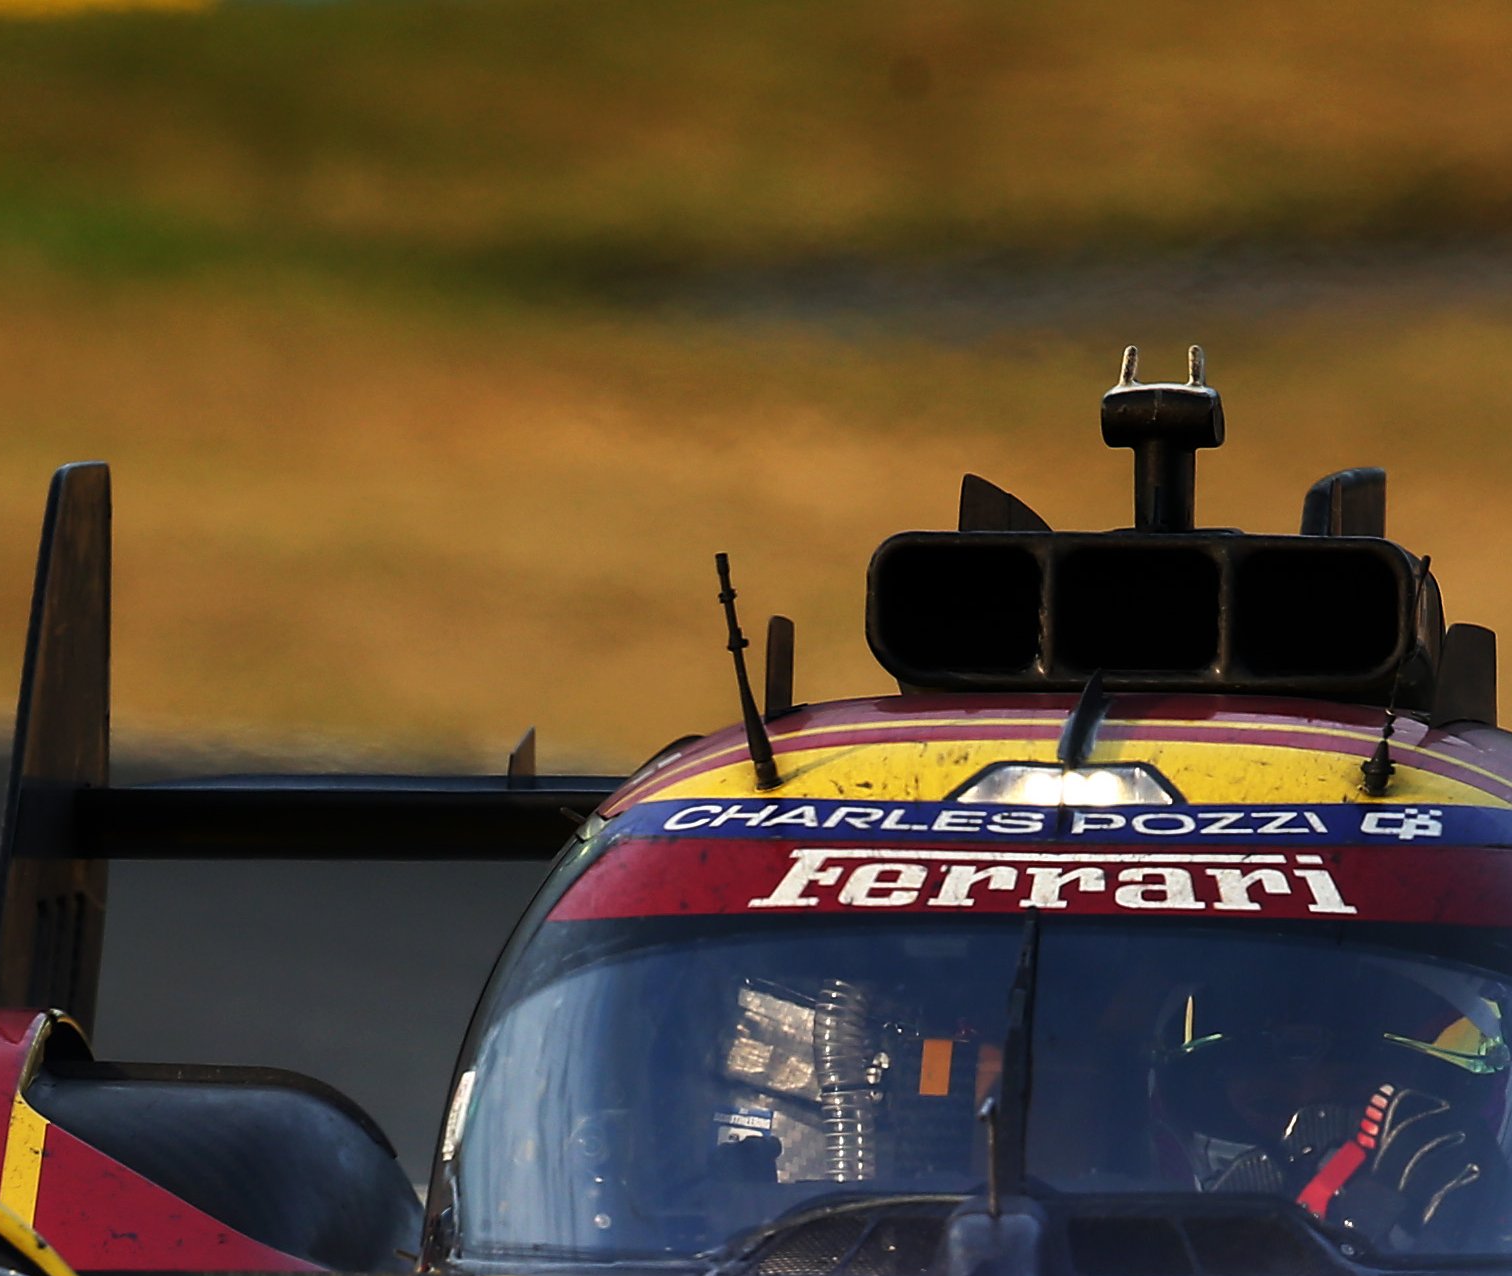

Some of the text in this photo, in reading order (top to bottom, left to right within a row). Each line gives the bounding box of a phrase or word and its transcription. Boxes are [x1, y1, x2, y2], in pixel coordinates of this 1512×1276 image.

[664, 804, 1044, 834] CHARLES
[1072, 811, 1327, 835] POZZI
[748, 848, 1358, 915] Ferrari
